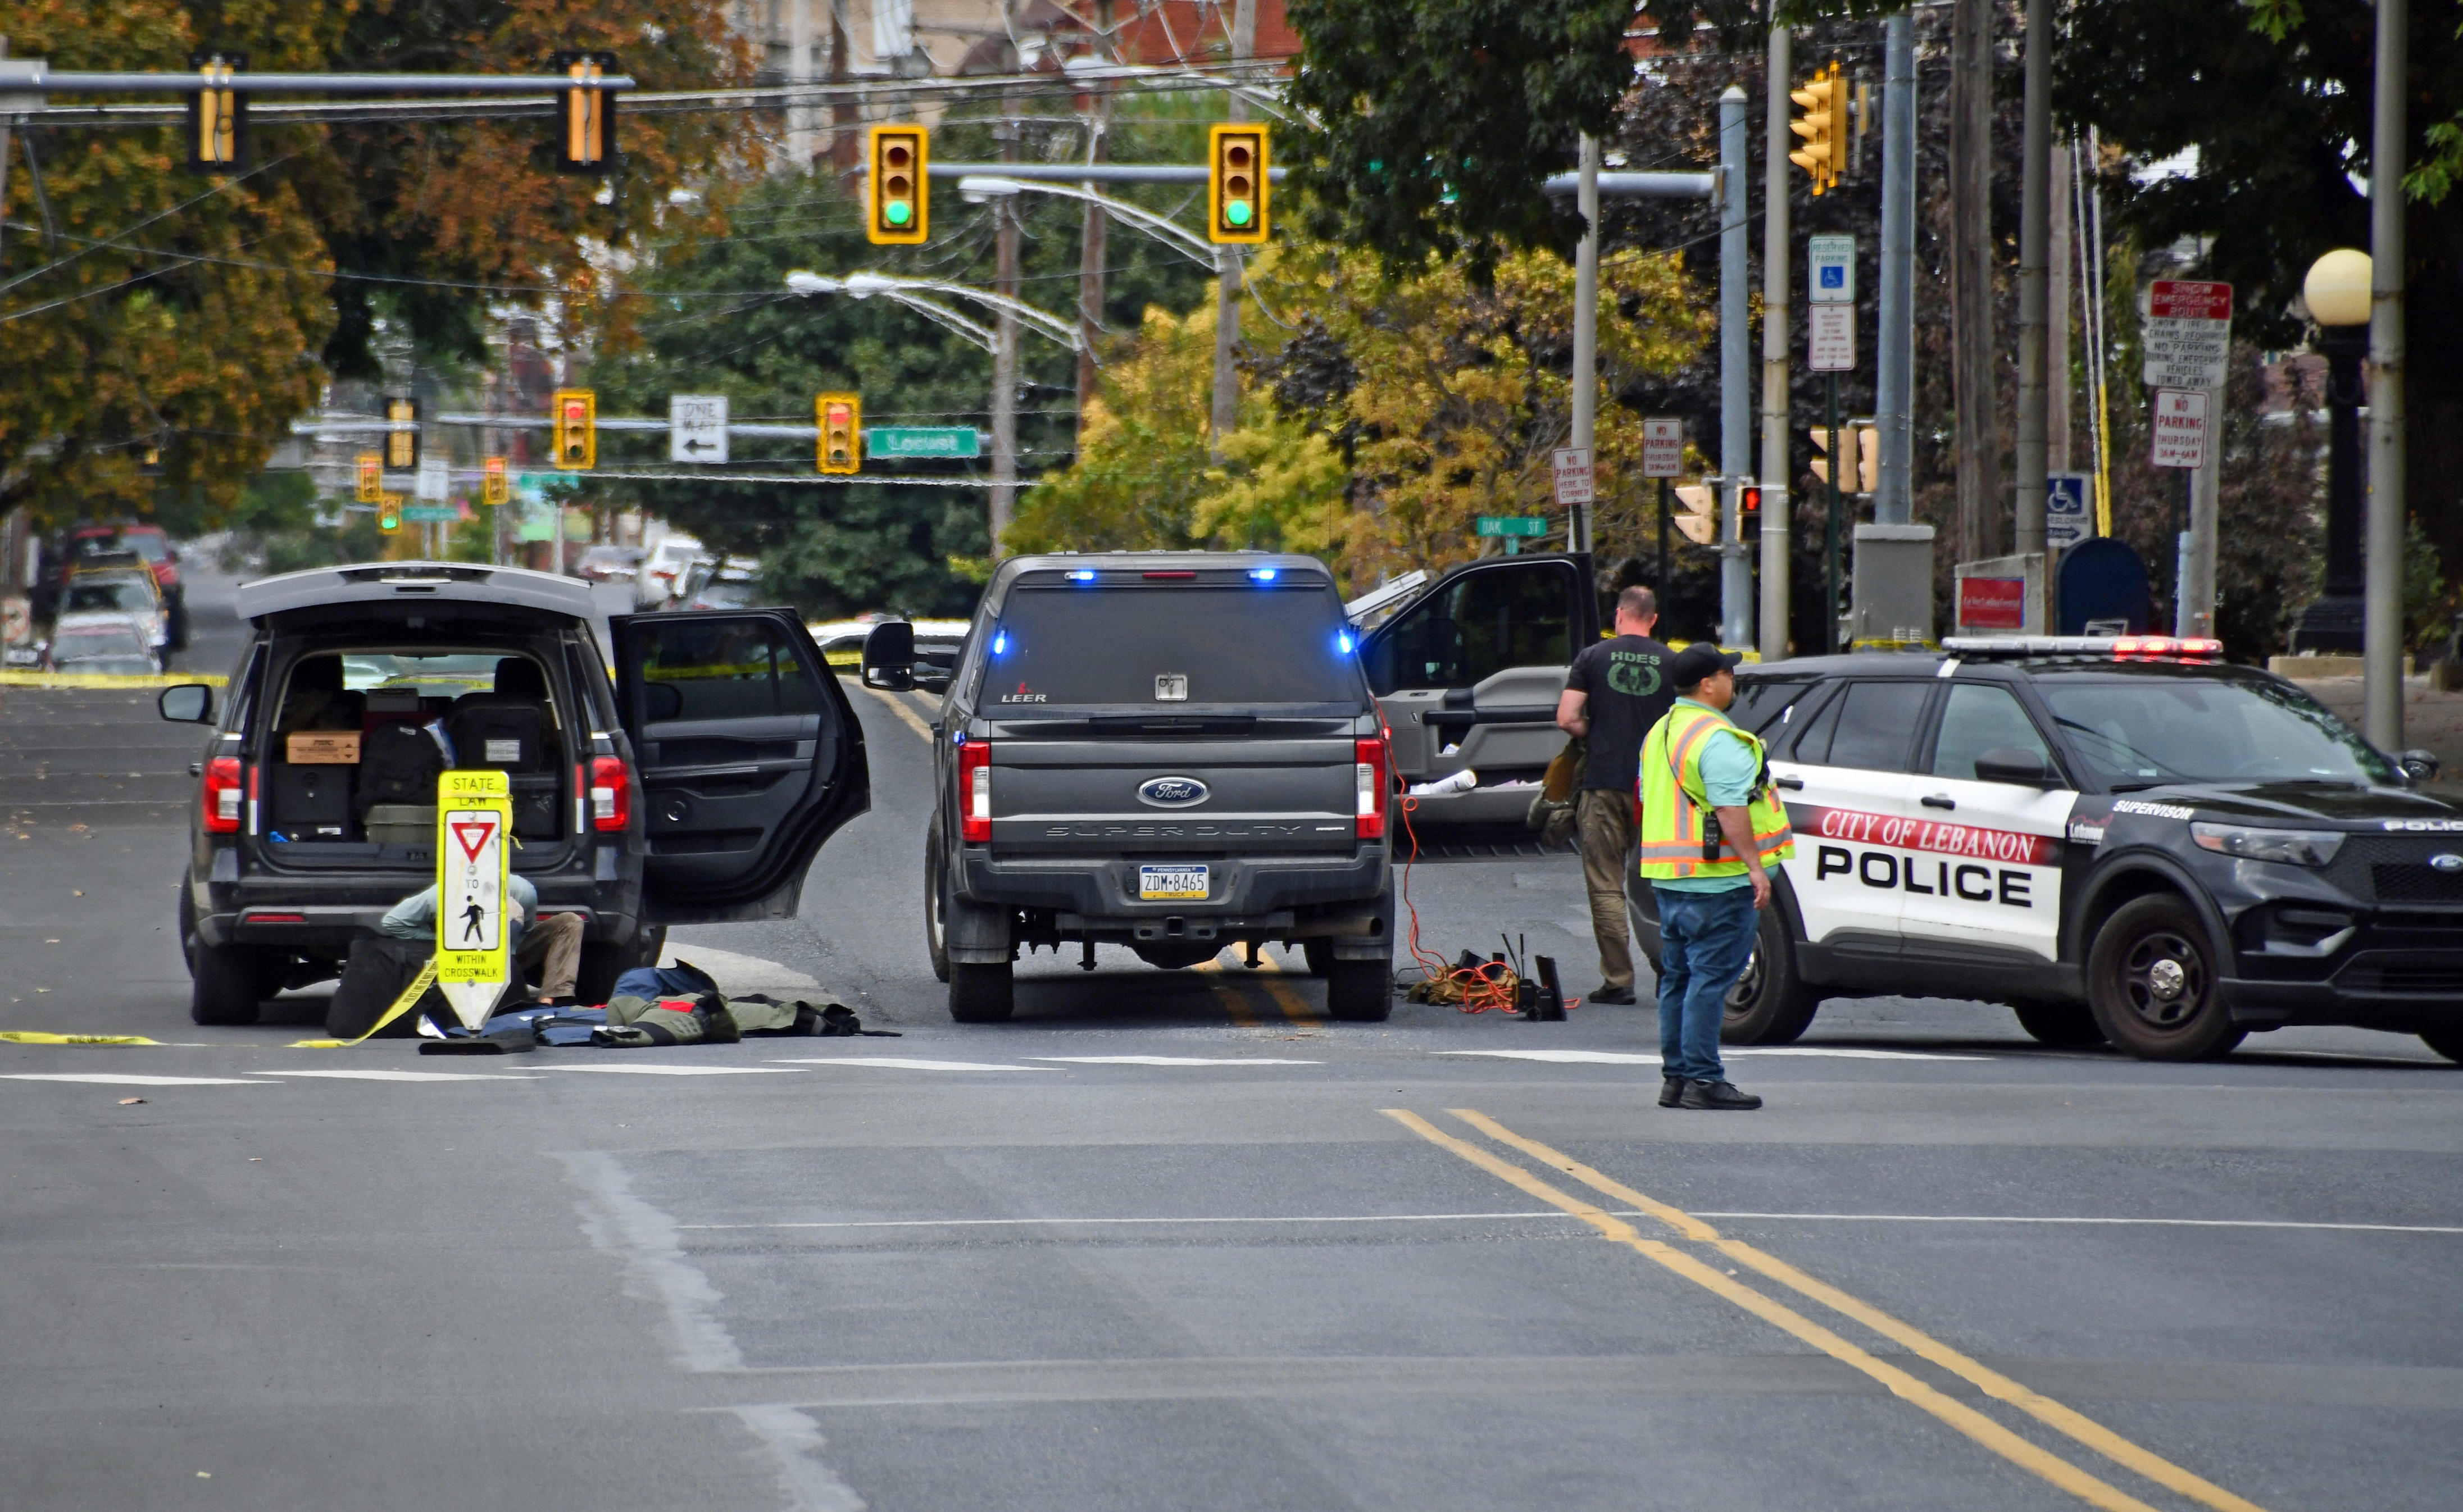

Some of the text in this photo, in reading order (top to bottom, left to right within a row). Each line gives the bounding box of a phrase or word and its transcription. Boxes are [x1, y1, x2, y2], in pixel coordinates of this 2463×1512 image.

[2173, 283, 2212, 294] SNOW
[2153, 295, 2226, 306] EMERGENCY
[2170, 307, 2209, 317] ROUTE
[2153, 319, 2177, 328] SNOW
[2150, 330, 2179, 340] CHAINS
[2155, 342, 2222, 354] NO PARKING
[2146, 352, 2174, 363] DURING
[2166, 365, 2203, 376] VEHICLES
[2156, 375, 2211, 387] TOWED AWAY
[684, 403, 716, 417] ONE
[2175, 399, 2189, 412] NO
[2158, 415, 2202, 430] PARKING
[1657, 426, 1667, 436] NO
[1646, 439, 1678, 449] PARKING
[2158, 435, 2201, 446] THURSDAY
[1566, 456, 1577, 466] NO
[1555, 467, 1589, 479] PARKING
[1559, 480, 1578, 489] HERE
[1561, 489, 1589, 499] CORNER
[1482, 521, 1539, 534] OAK ST
[1611, 652, 1660, 665] HDES
[1001, 694, 1047, 703] LEER
[453, 778, 494, 790] STATE
[1155, 783, 1192, 798] Ford
[460, 797, 487, 807] LAW
[2113, 800, 2194, 821] SUPERVISOR
[1046, 825, 1301, 837] SUPER DUTY
[1822, 809, 2036, 863] CITY OF LEBANON
[1817, 845, 2033, 908] POLICE
[466, 879, 479, 889] TO
[456, 955, 487, 964] WITHIN
[445, 968, 498, 977] CROSSWALK
